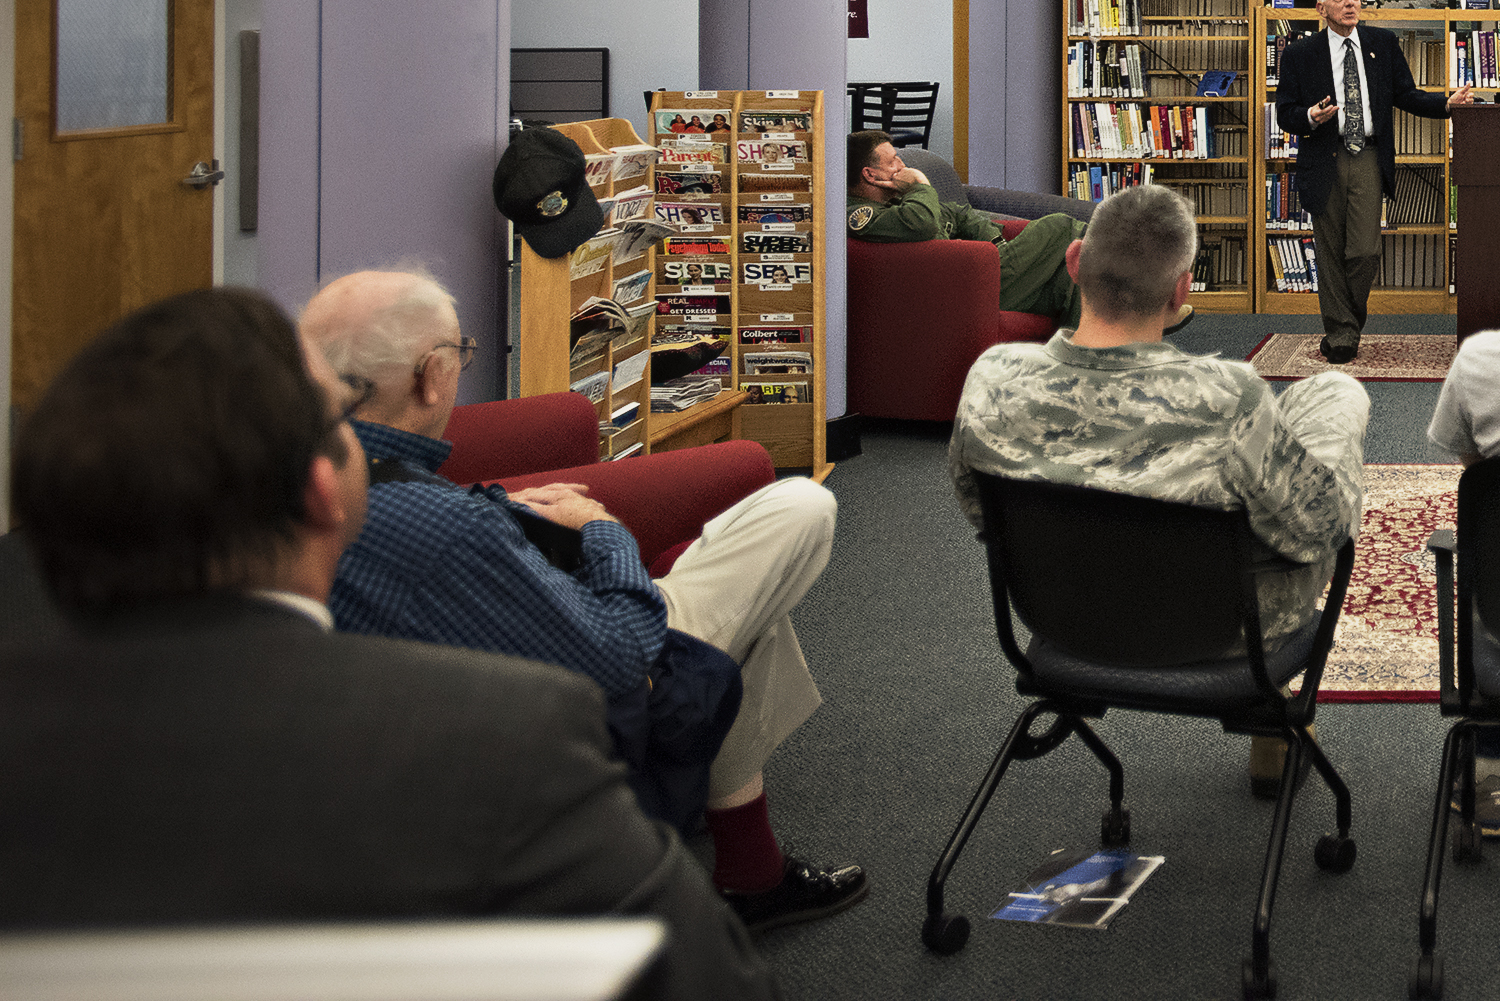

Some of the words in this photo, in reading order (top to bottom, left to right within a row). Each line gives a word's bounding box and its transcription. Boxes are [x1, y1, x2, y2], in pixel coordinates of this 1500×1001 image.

[662, 148, 719, 163] Parents
[738, 143, 804, 160] SHPE
[655, 206, 722, 222] SHPE
[745, 236, 802, 246] SUPER
[743, 330, 778, 338] Colbert
